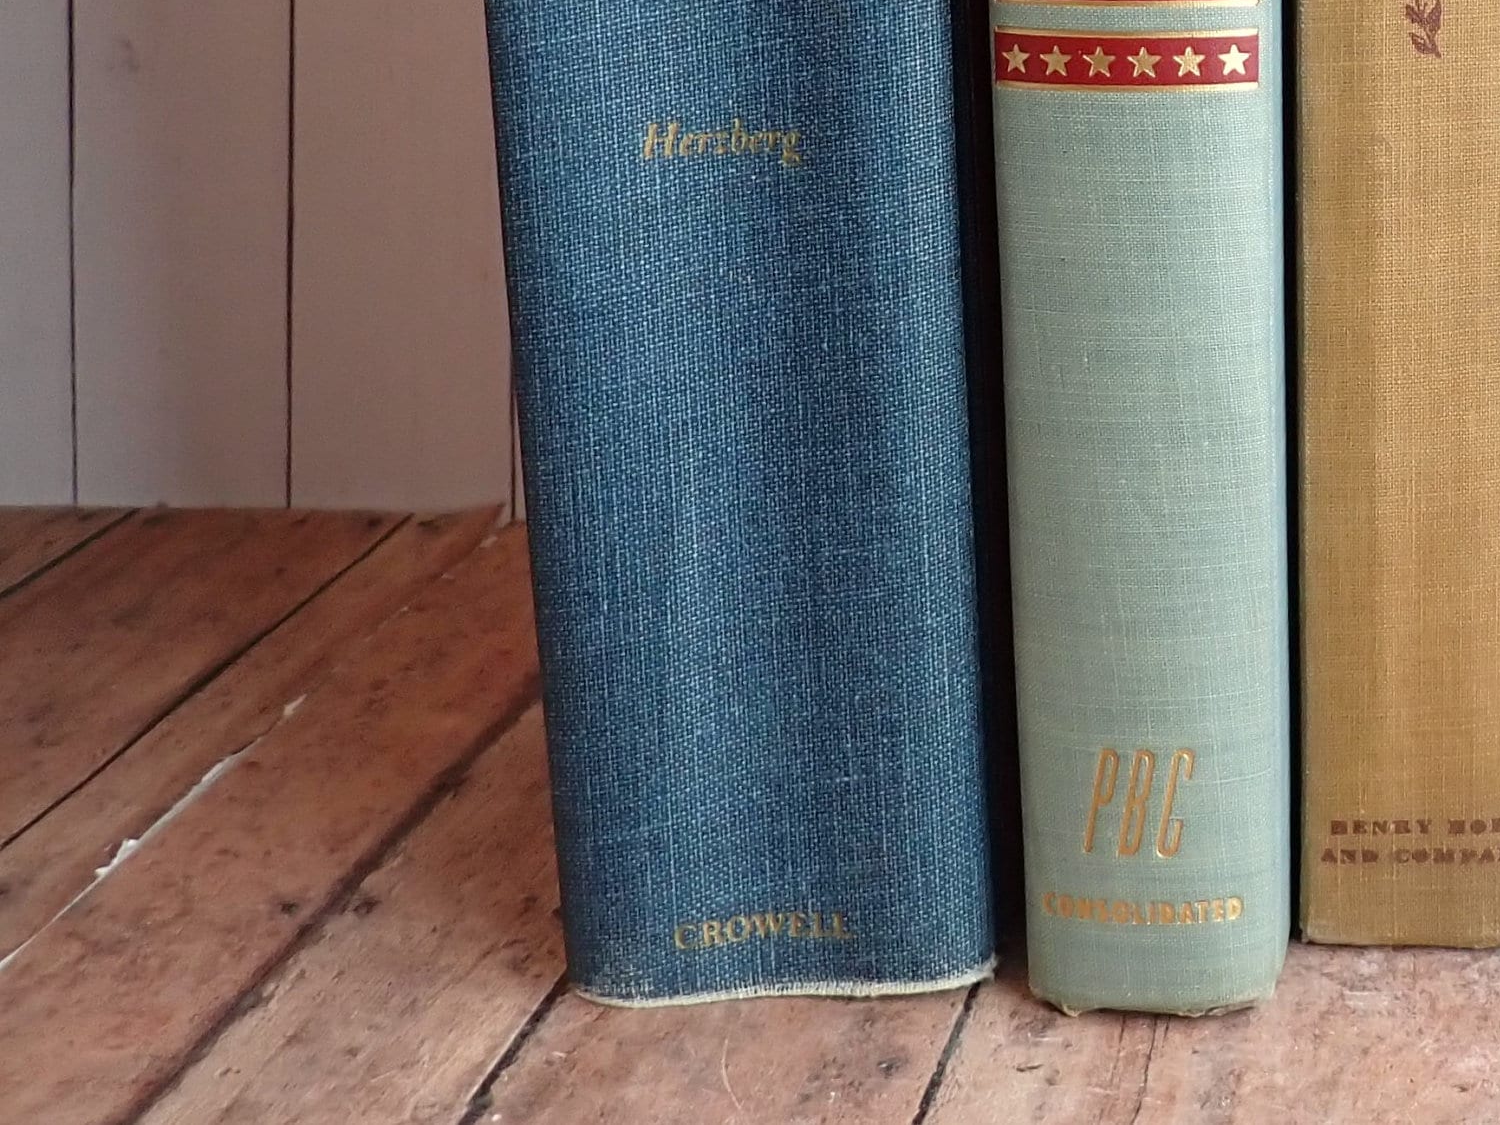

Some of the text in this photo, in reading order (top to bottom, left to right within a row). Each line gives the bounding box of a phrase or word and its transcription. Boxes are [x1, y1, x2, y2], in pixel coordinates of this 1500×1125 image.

[1321, 848, 1379, 864] AND
[1042, 891, 1244, 925] CONSOLIDATED
[673, 911, 852, 949] CROWELL
